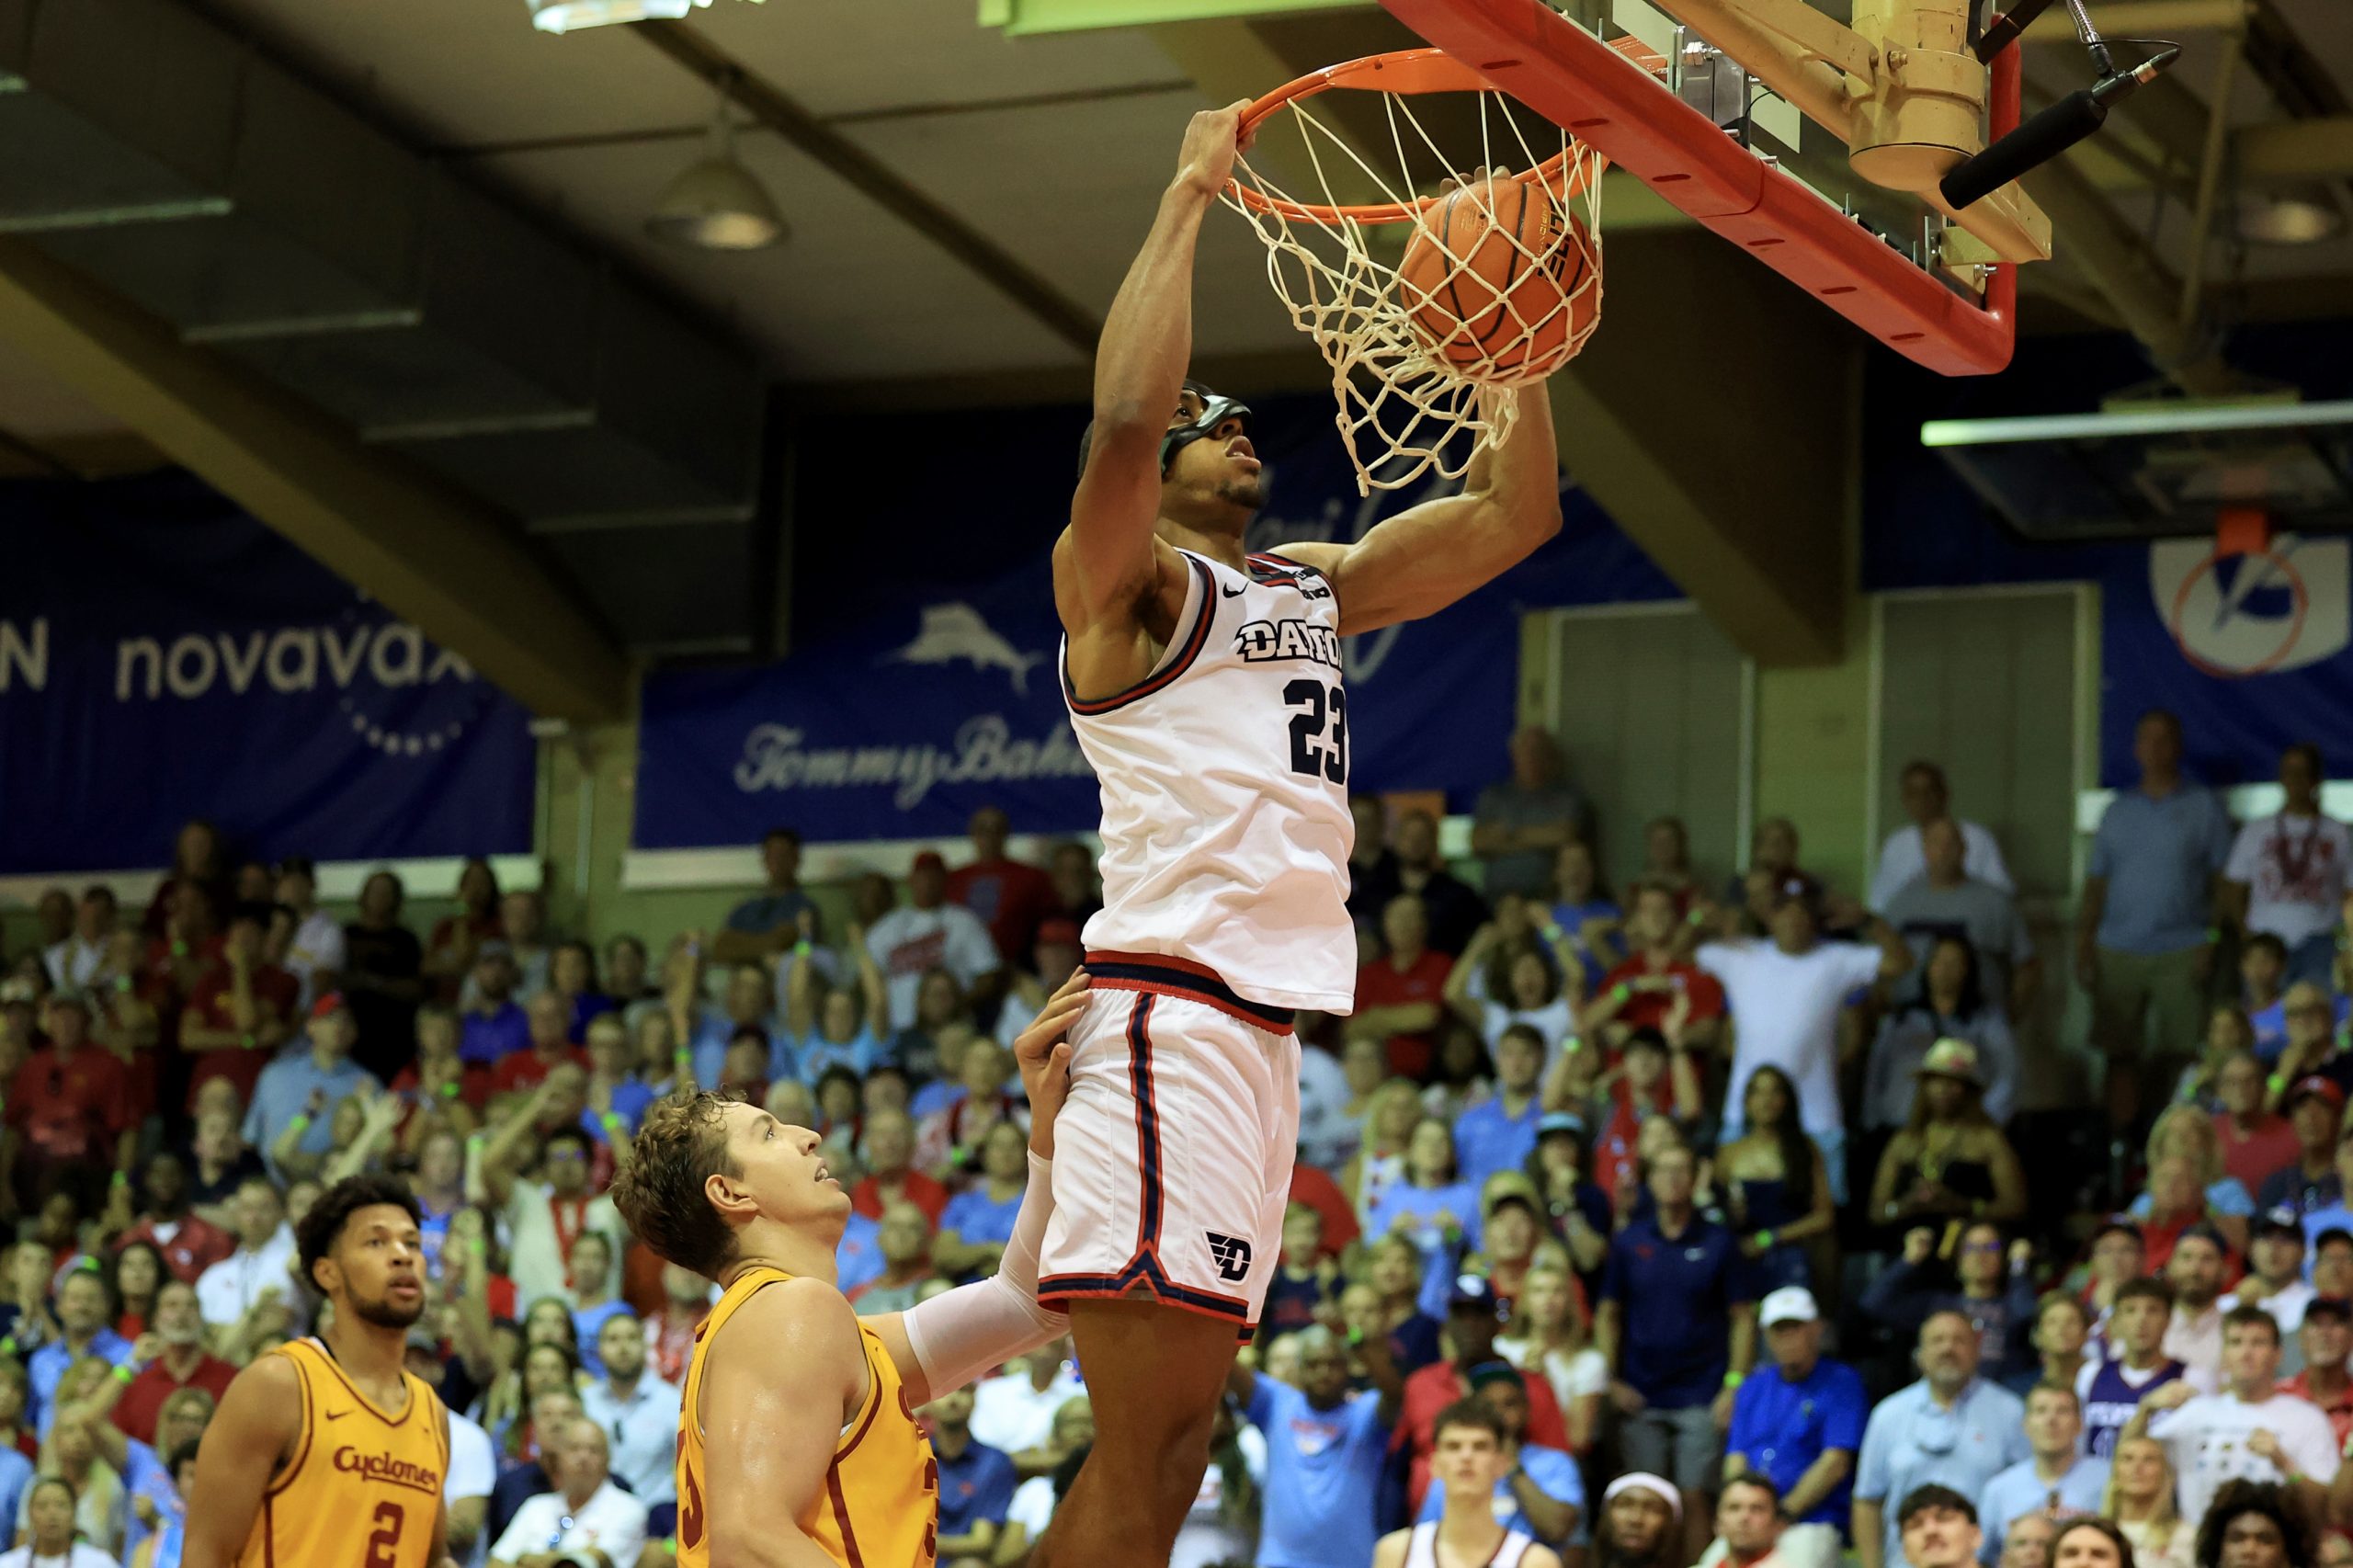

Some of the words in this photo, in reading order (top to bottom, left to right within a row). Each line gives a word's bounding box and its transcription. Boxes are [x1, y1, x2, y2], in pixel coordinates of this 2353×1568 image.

[1234, 619, 1343, 673] DAYTO
[732, 722, 939, 812] Tommy
[1283, 679, 1346, 785] 23
[365, 1501, 404, 1568] 2
